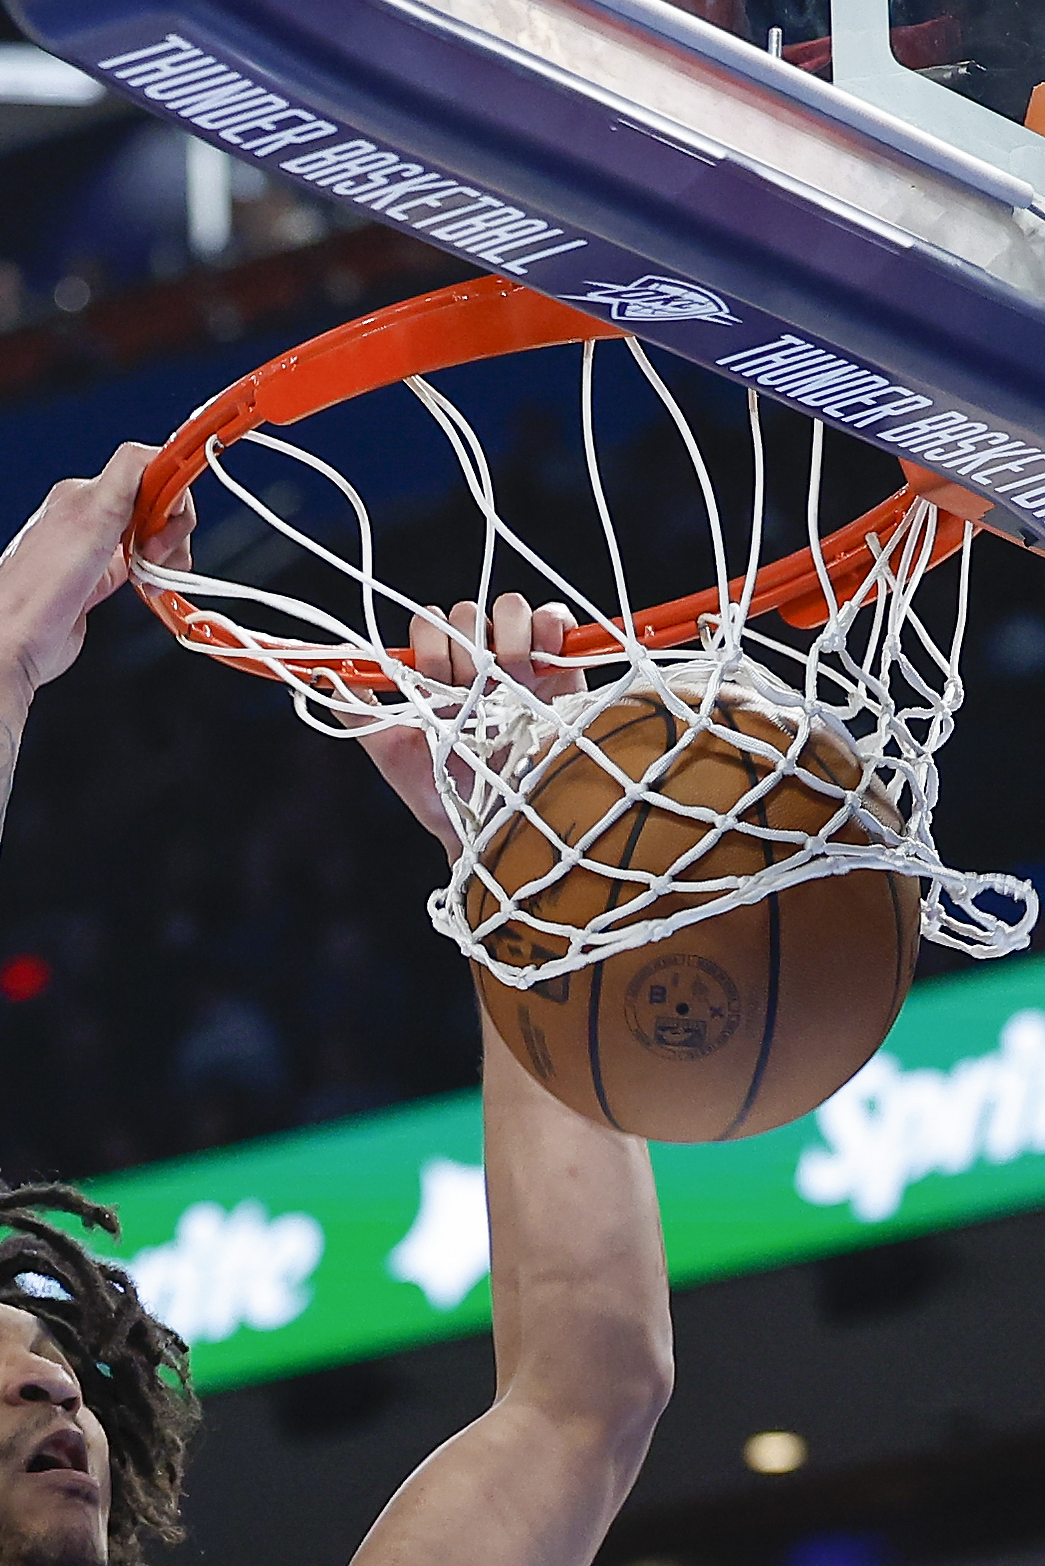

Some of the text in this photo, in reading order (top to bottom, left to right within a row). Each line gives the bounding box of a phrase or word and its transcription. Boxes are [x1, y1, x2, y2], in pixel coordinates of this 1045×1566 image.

[97, 33, 589, 276] THUNDER BASKETBALL
[715, 333, 934, 429] THUNDER
